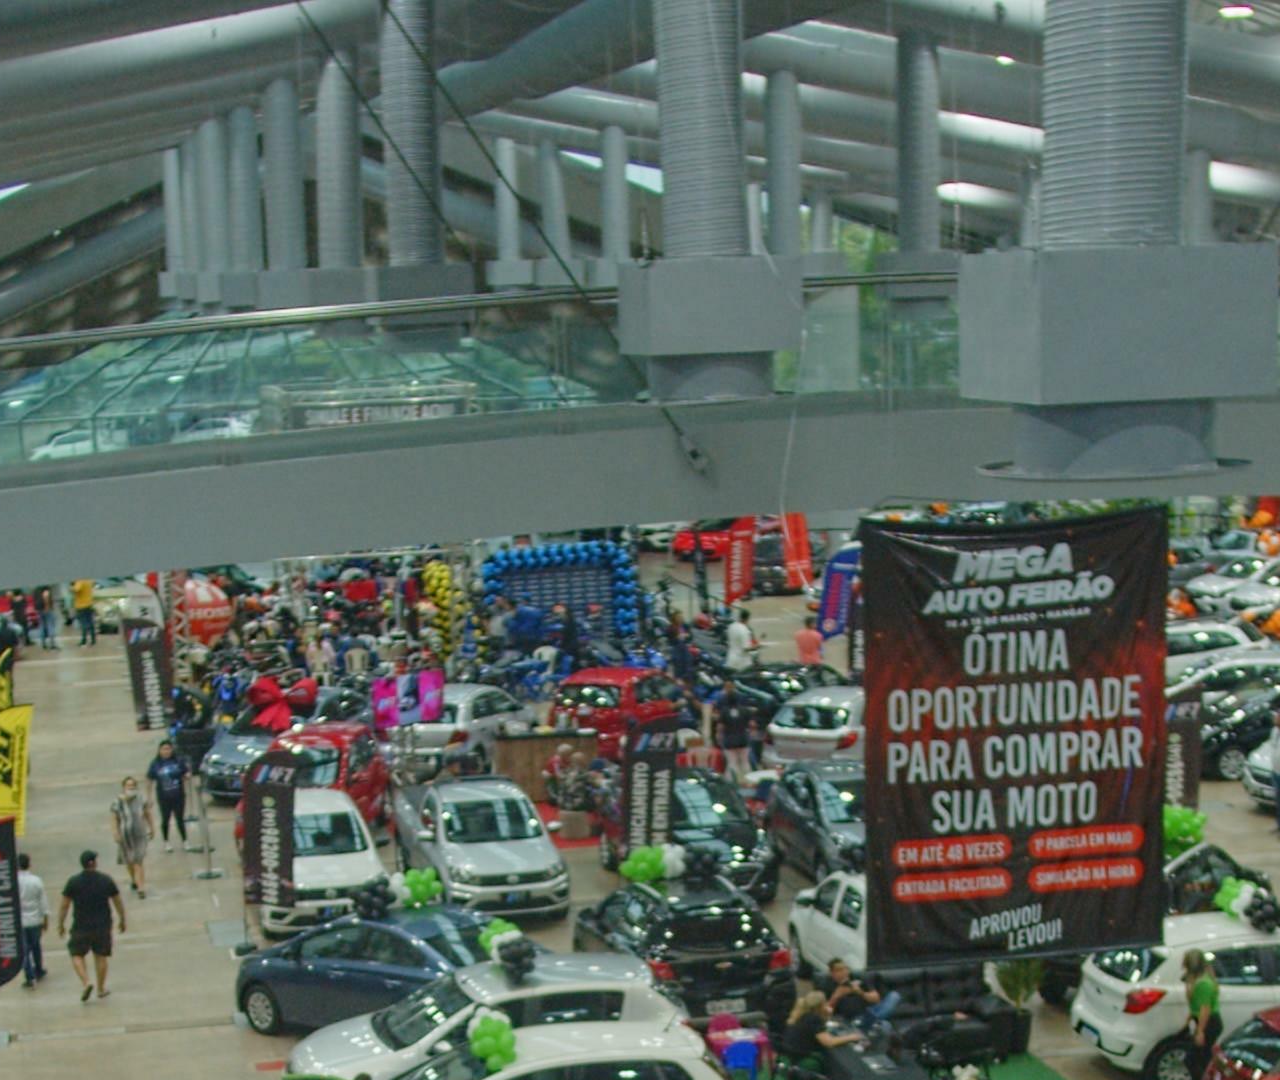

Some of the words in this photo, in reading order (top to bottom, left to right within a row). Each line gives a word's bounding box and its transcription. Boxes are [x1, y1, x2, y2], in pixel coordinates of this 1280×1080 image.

[952, 542, 1073, 583] MEGA
[922, 585, 1005, 615] AUTO
[1006, 571, 1115, 608] FEIRÃO
[964, 624, 1069, 675] ÓTIMA
[887, 674, 1142, 733] OPORTUNIDADE
[887, 738, 974, 784] PARA
[984, 726, 1143, 779] COMPRAR
[932, 789, 996, 833] SUA
[1007, 781, 1097, 828] MOTO
[898, 847, 918, 863] EM
[922, 844, 943, 863] ATÉ
[967, 841, 1005, 858] VEZES
[1047, 834, 1087, 850] PARCELA
[1089, 832, 1105, 847] EM
[897, 878, 946, 896] ENTRADA
[948, 875, 1006, 894] FACILITADA
[1036, 867, 1090, 885] SIMULAÇÃO
[1092, 866, 1106, 880] NA
[1108, 865, 1136, 880] HORA
[969, 904, 1043, 940] APROVOU
[1008, 918, 1062, 951] LEVOU!
